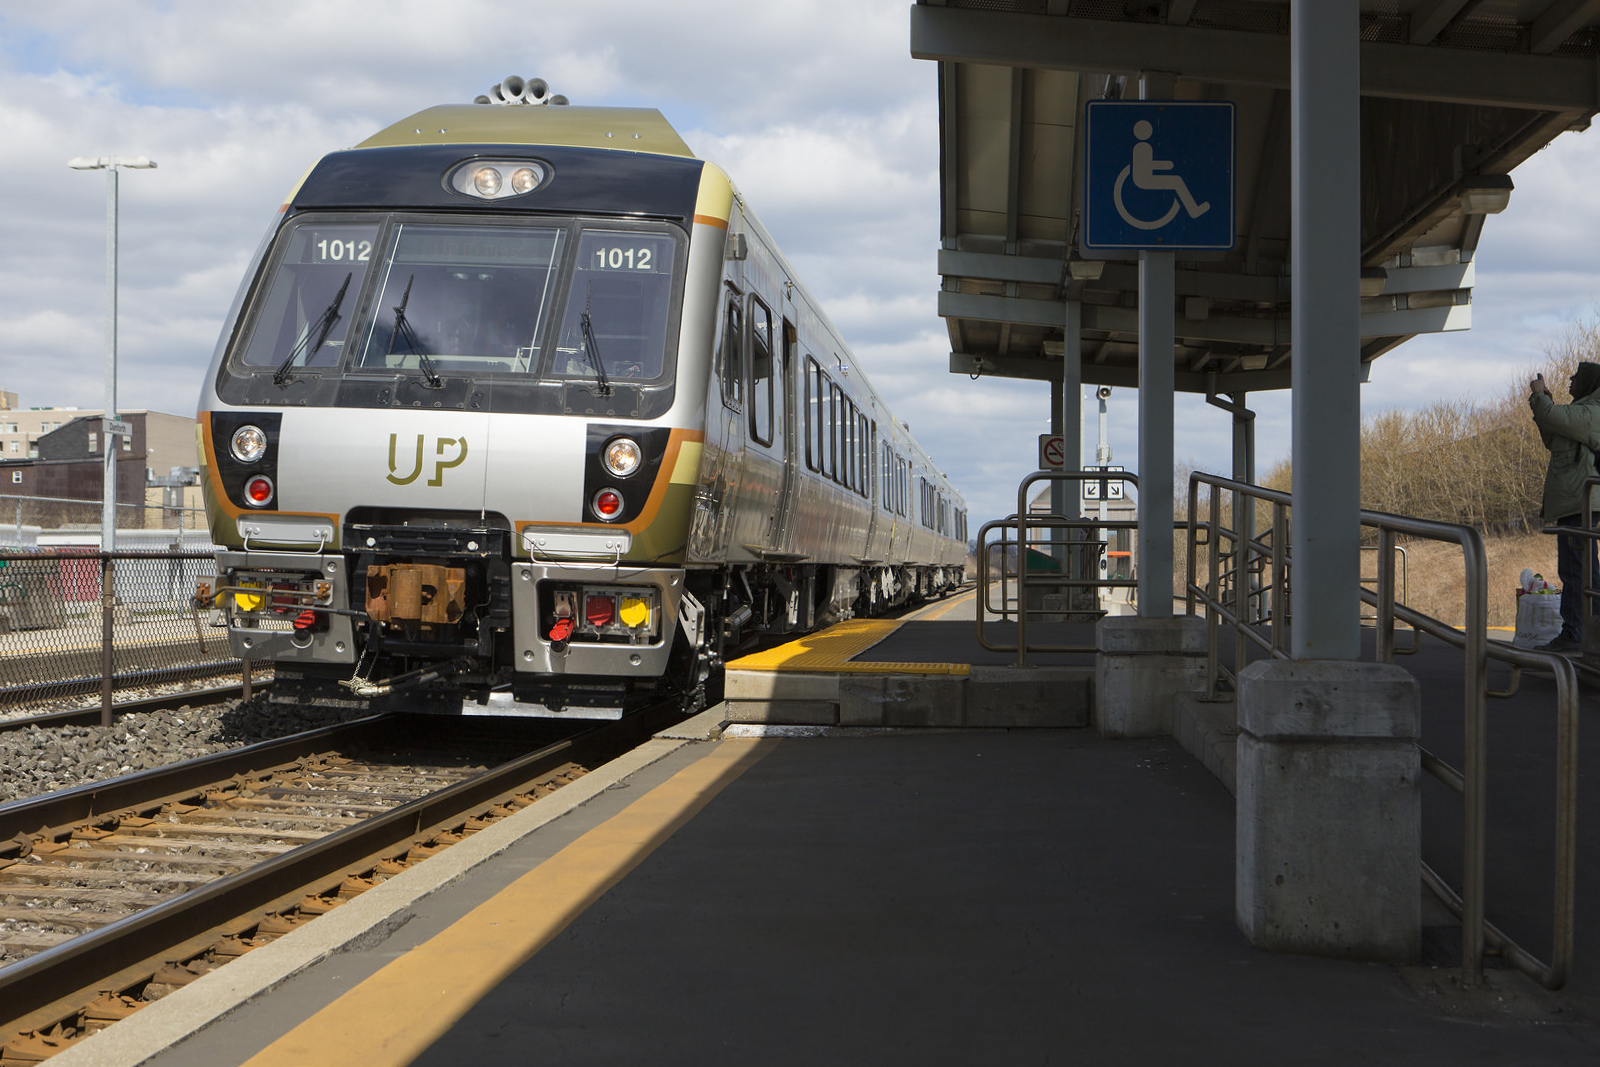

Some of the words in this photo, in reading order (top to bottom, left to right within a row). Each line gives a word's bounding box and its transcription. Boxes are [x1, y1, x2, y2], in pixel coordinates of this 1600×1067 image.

[317, 239, 372, 261] 1012
[596, 247, 652, 270] 1012
[386, 433, 468, 487] UP
